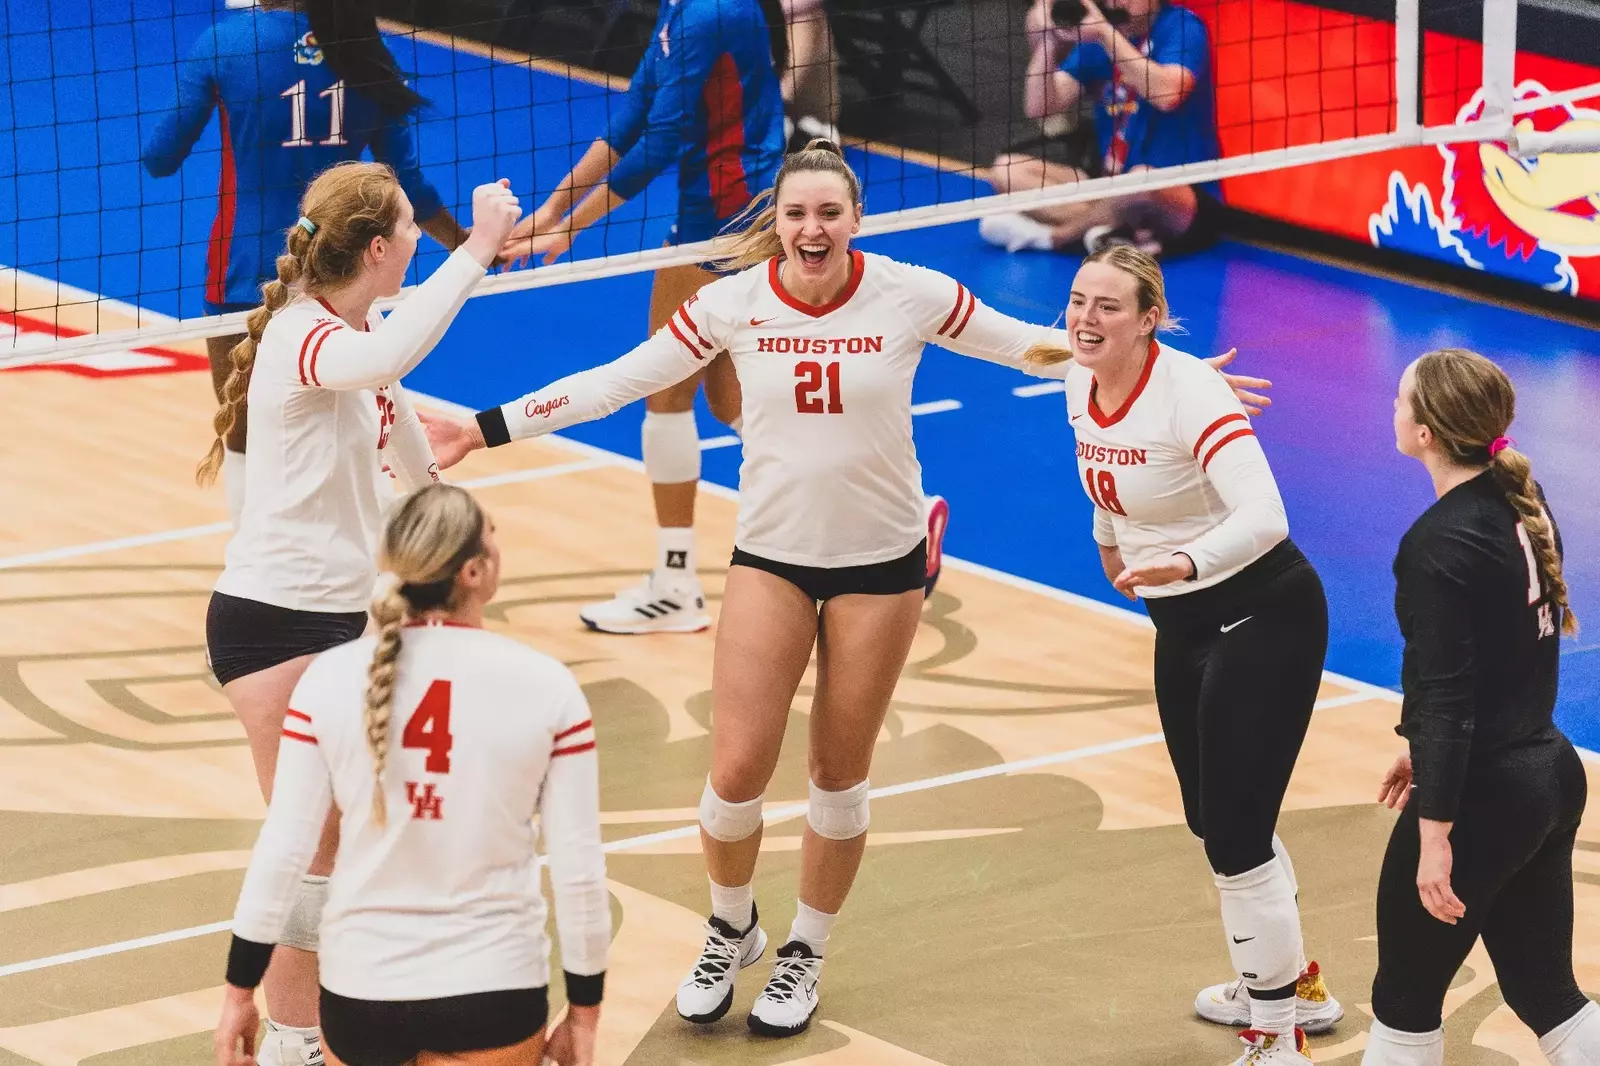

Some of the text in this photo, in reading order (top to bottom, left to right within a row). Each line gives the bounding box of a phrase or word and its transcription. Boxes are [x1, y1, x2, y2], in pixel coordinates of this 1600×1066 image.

[280, 79, 348, 147] 11
[757, 336, 884, 355] HOUSTON
[525, 395, 570, 418] Cougars
[794, 361, 844, 414] 21
[1076, 440, 1147, 465] OUSTON
[1086, 467, 1128, 517] 18
[402, 679, 453, 774] 4
[405, 781, 445, 821] UH
